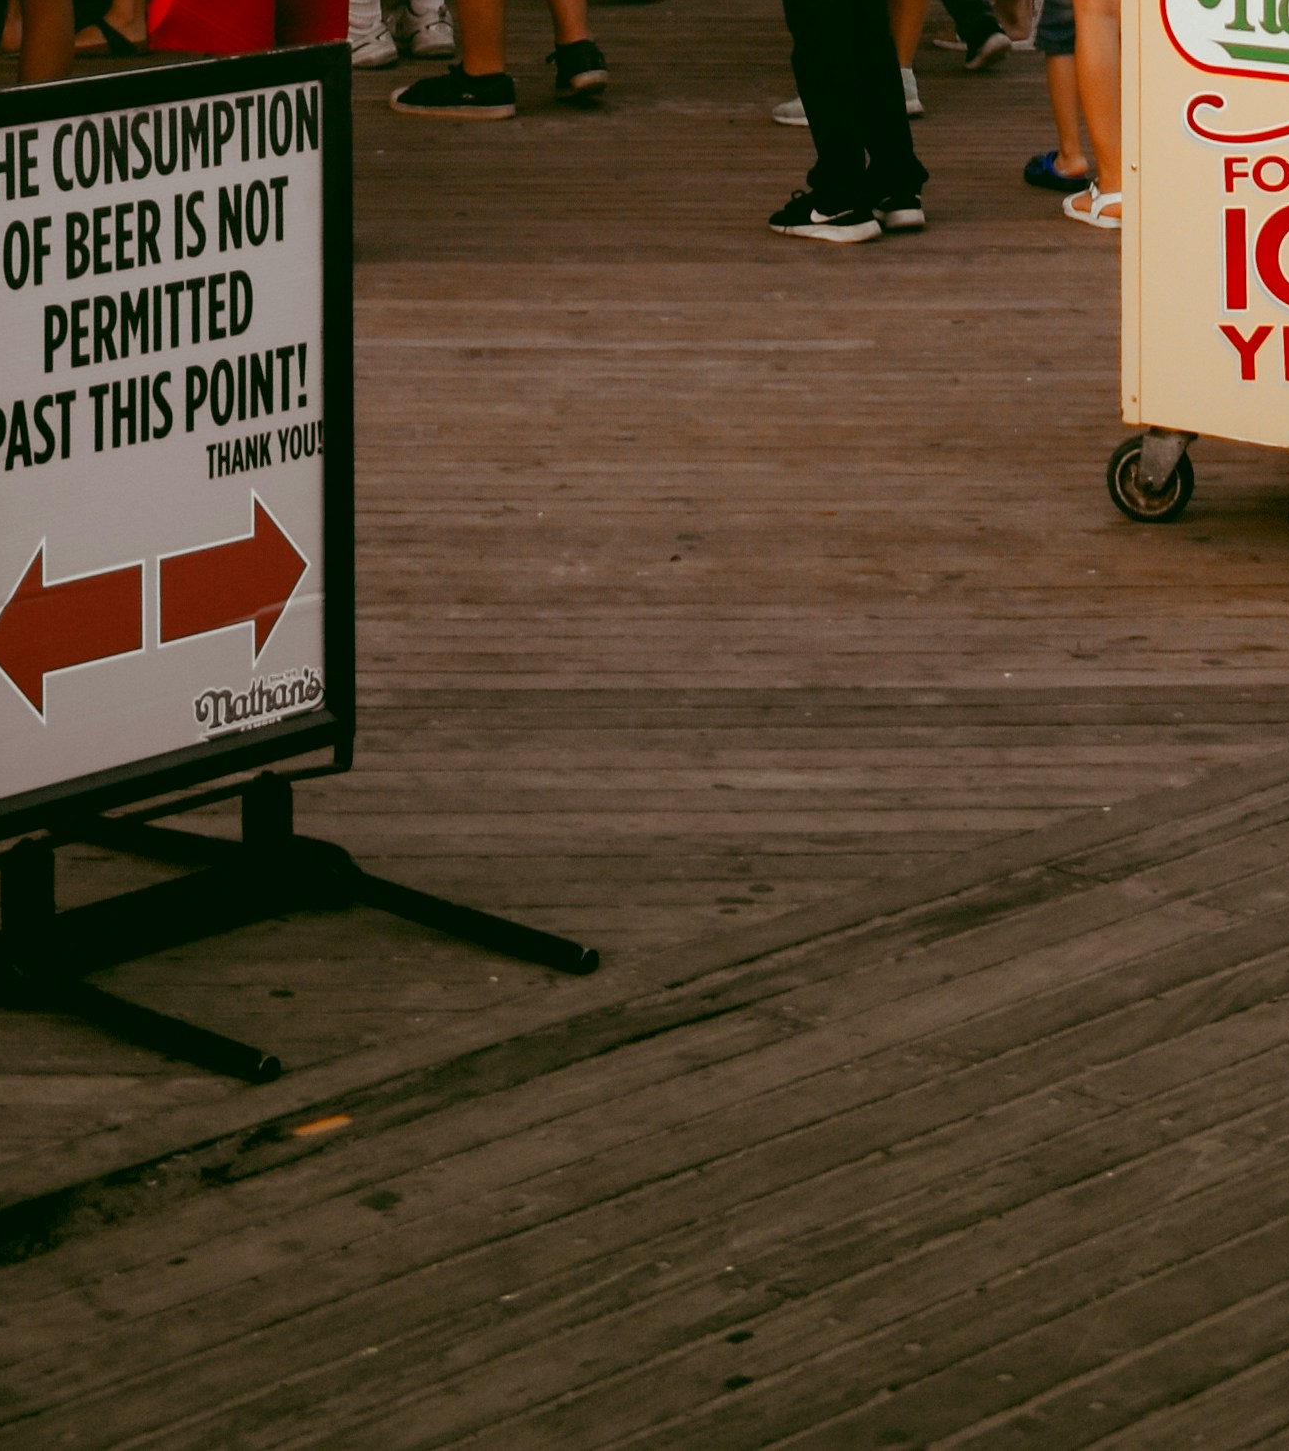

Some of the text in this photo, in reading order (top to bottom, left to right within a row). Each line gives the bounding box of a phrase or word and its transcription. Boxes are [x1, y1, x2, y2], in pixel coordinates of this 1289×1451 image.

[52, 86, 320, 188] CONSUMPTION
[2, 176, 290, 293] OF BEER IS NOT
[42, 269, 254, 374] PERMITTED
[88, 369, 173, 455] THIS
[184, 343, 309, 427] POINT!
[206, 417, 325, 480] THANK YOU!
[194, 668, 323, 730] Nathan's
